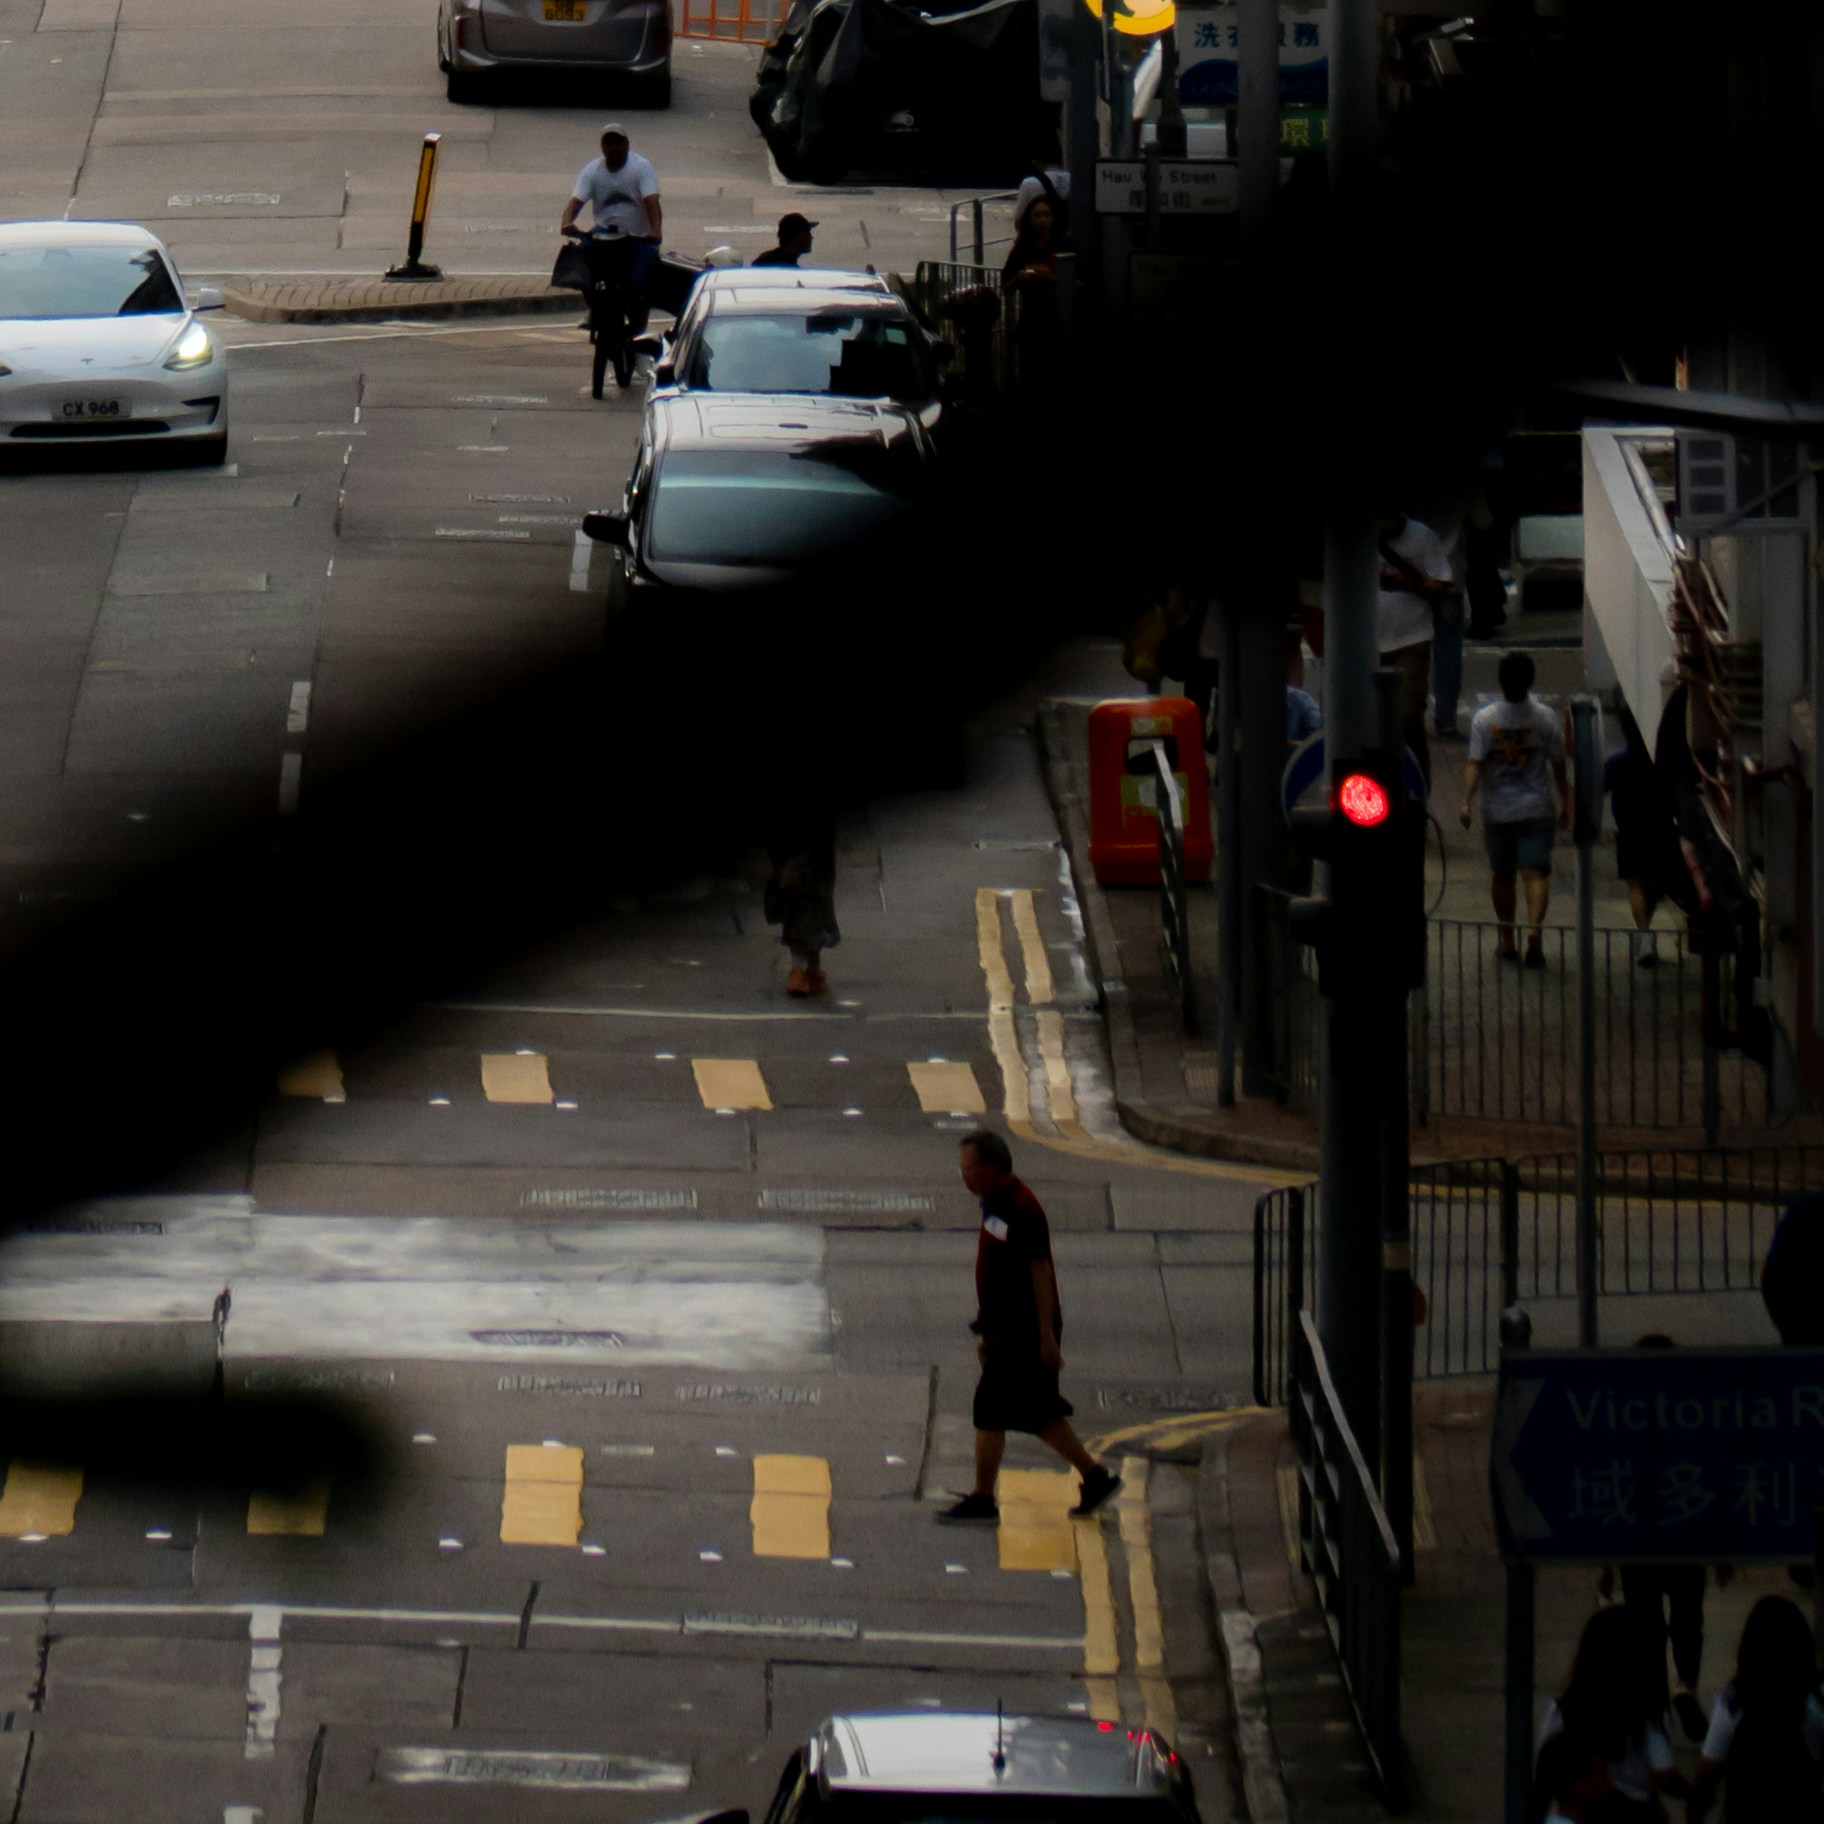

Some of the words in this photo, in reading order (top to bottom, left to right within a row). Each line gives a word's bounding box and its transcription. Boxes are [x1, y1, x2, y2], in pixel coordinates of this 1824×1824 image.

[1101, 168, 1132, 184] Hau
[1169, 169, 1218, 185] Street
[63, 402, 84, 417] CX
[89, 400, 120, 415] 968
[1565, 1381, 1779, 1433] Victoria
[1566, 1457, 1824, 1529] 域多利
